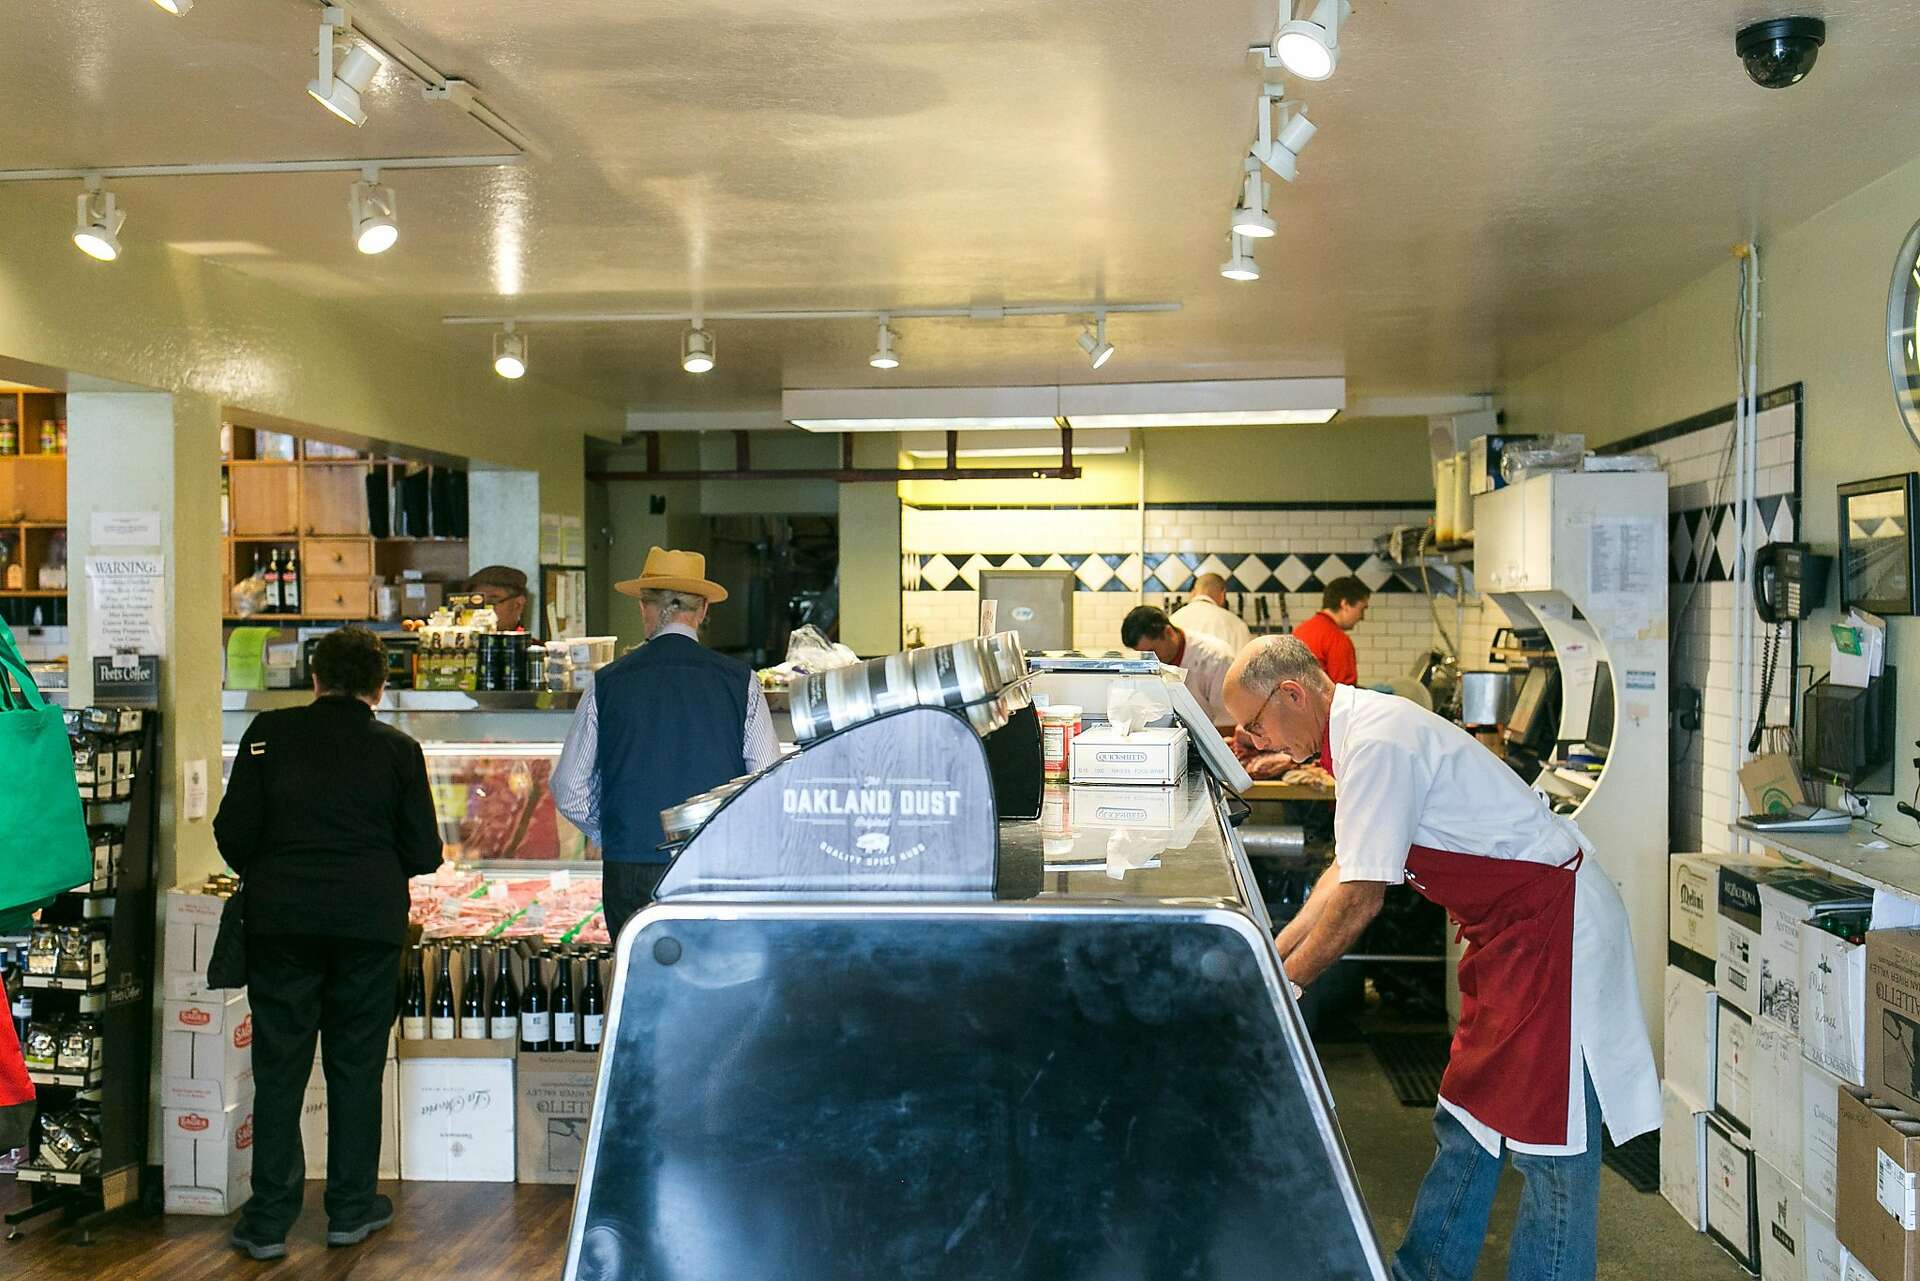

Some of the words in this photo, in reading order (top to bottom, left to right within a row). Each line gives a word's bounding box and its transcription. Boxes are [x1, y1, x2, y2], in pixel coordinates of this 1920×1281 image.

[95, 561, 156, 574] WARNING:
[123, 666, 151, 681] Coffee
[783, 789, 892, 815] OAKLAND
[901, 789, 961, 816] DUST
[819, 841, 862, 865] QUALITY
[866, 855, 897, 867] SPICE
[900, 843, 926, 861] RUBS
[1876, 981, 1920, 1016] ALLETTO
[537, 1100, 592, 1114] LETTO
